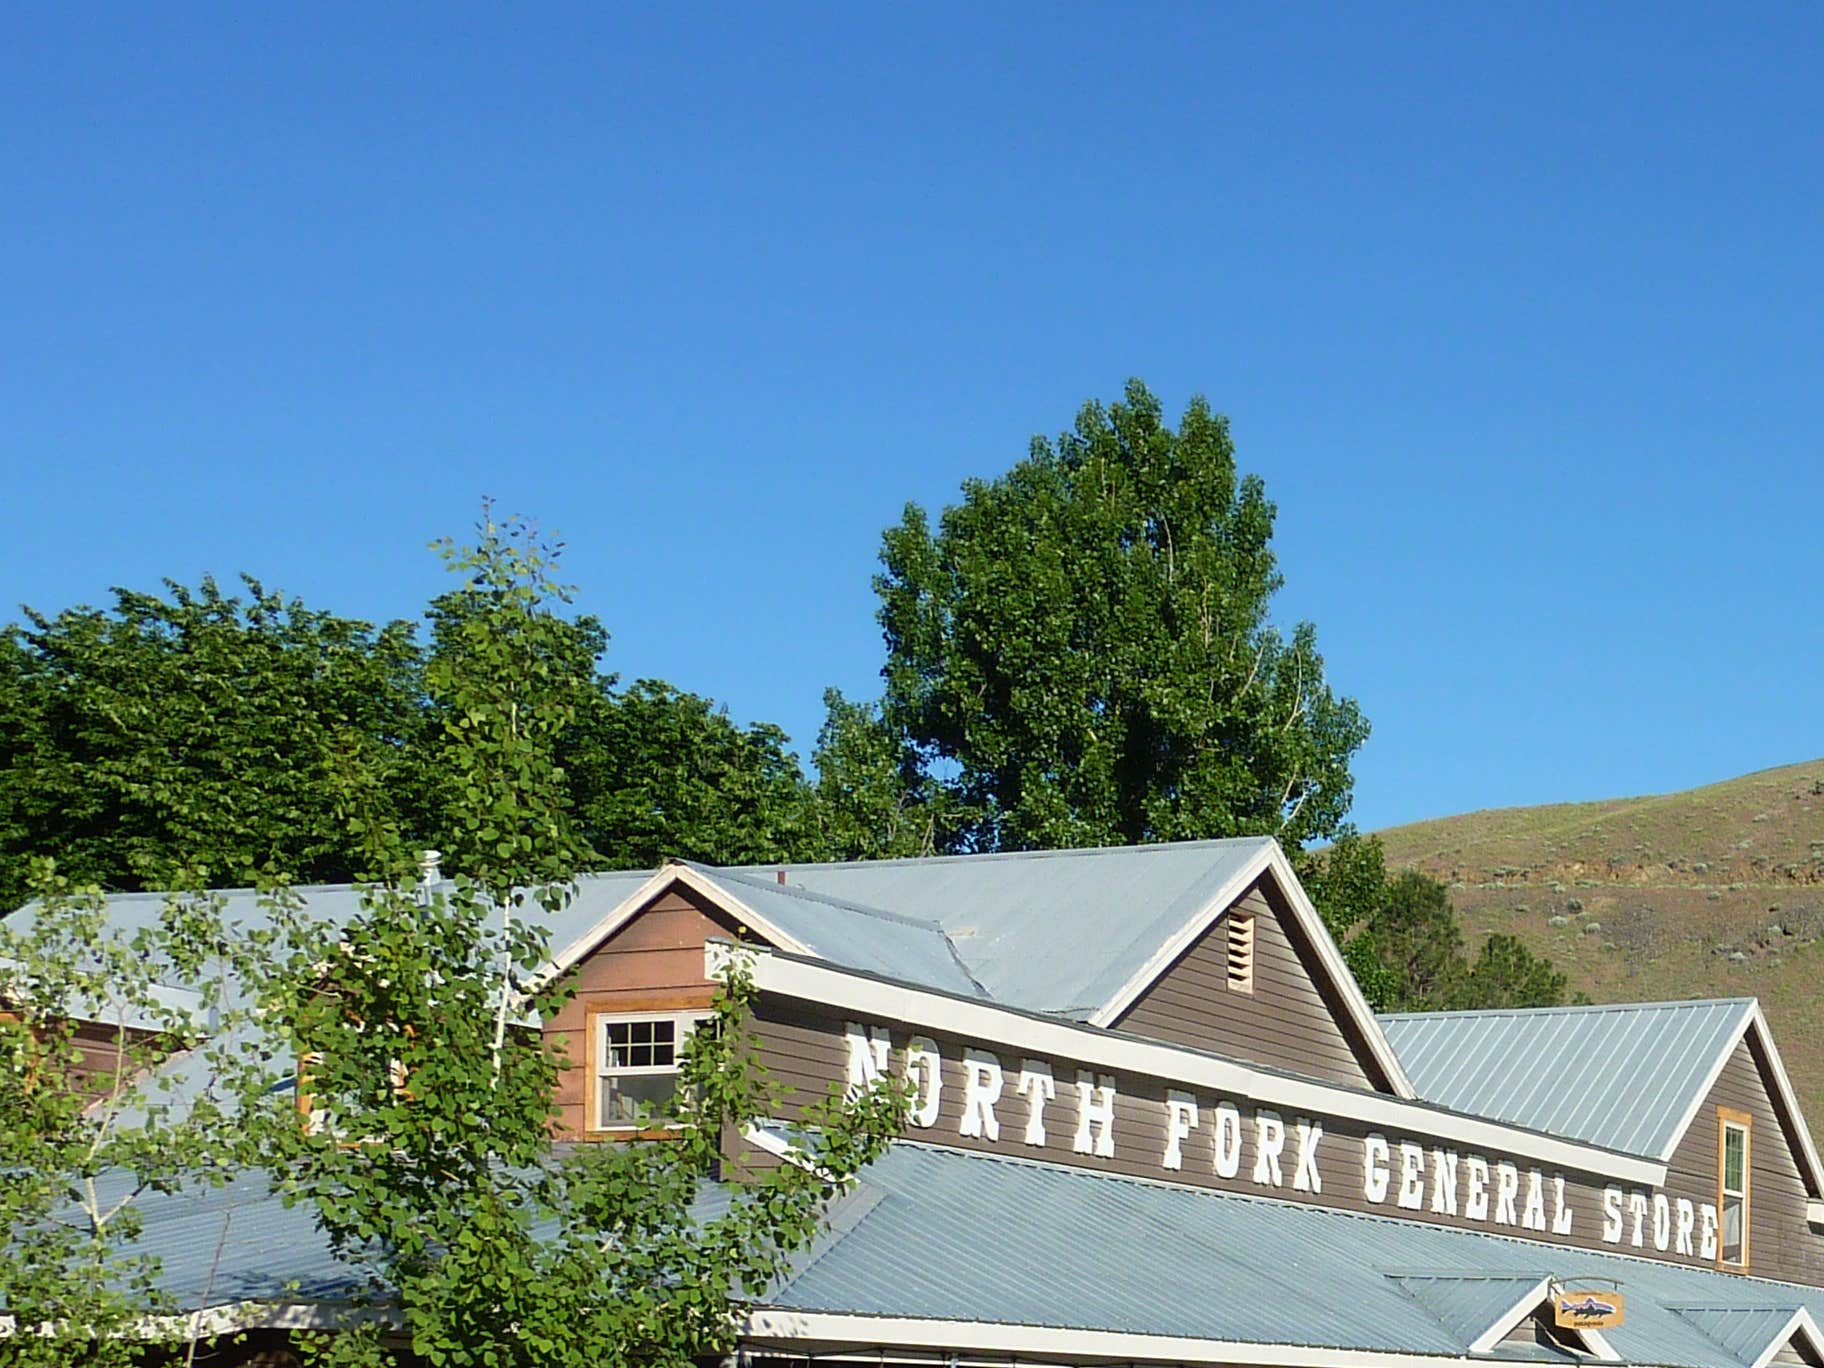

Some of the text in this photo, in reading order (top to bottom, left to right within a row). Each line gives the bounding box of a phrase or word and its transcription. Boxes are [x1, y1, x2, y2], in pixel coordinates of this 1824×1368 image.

[842, 1021, 1719, 1261] NORTH FORK GENERAL STORE
